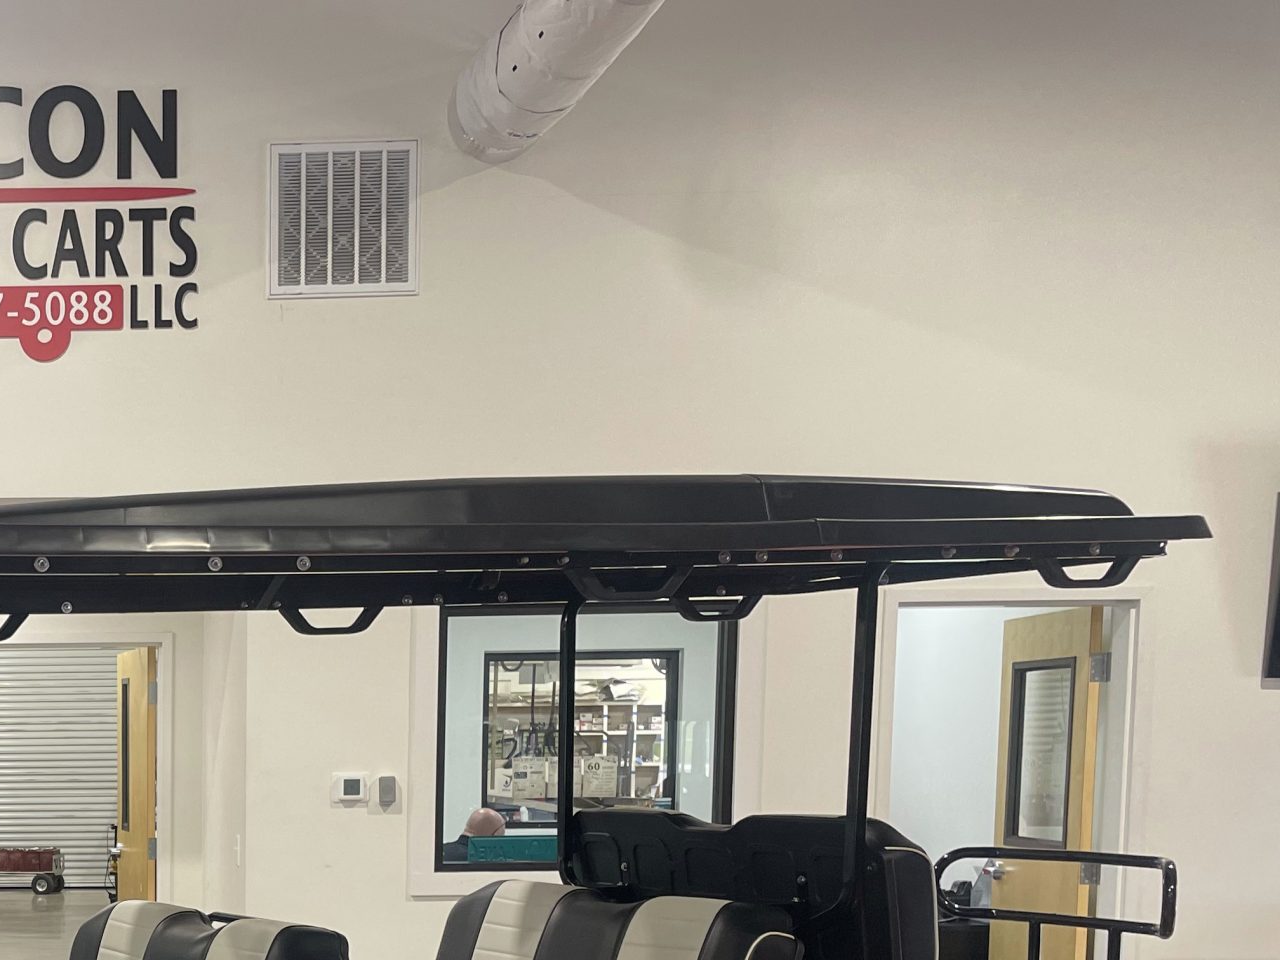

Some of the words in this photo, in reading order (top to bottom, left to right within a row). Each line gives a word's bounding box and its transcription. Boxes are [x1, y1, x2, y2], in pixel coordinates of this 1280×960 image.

[11, 205, 199, 281] CARTS
[129, 282, 199, 330] LLC
[587, 761, 601, 771] 60
